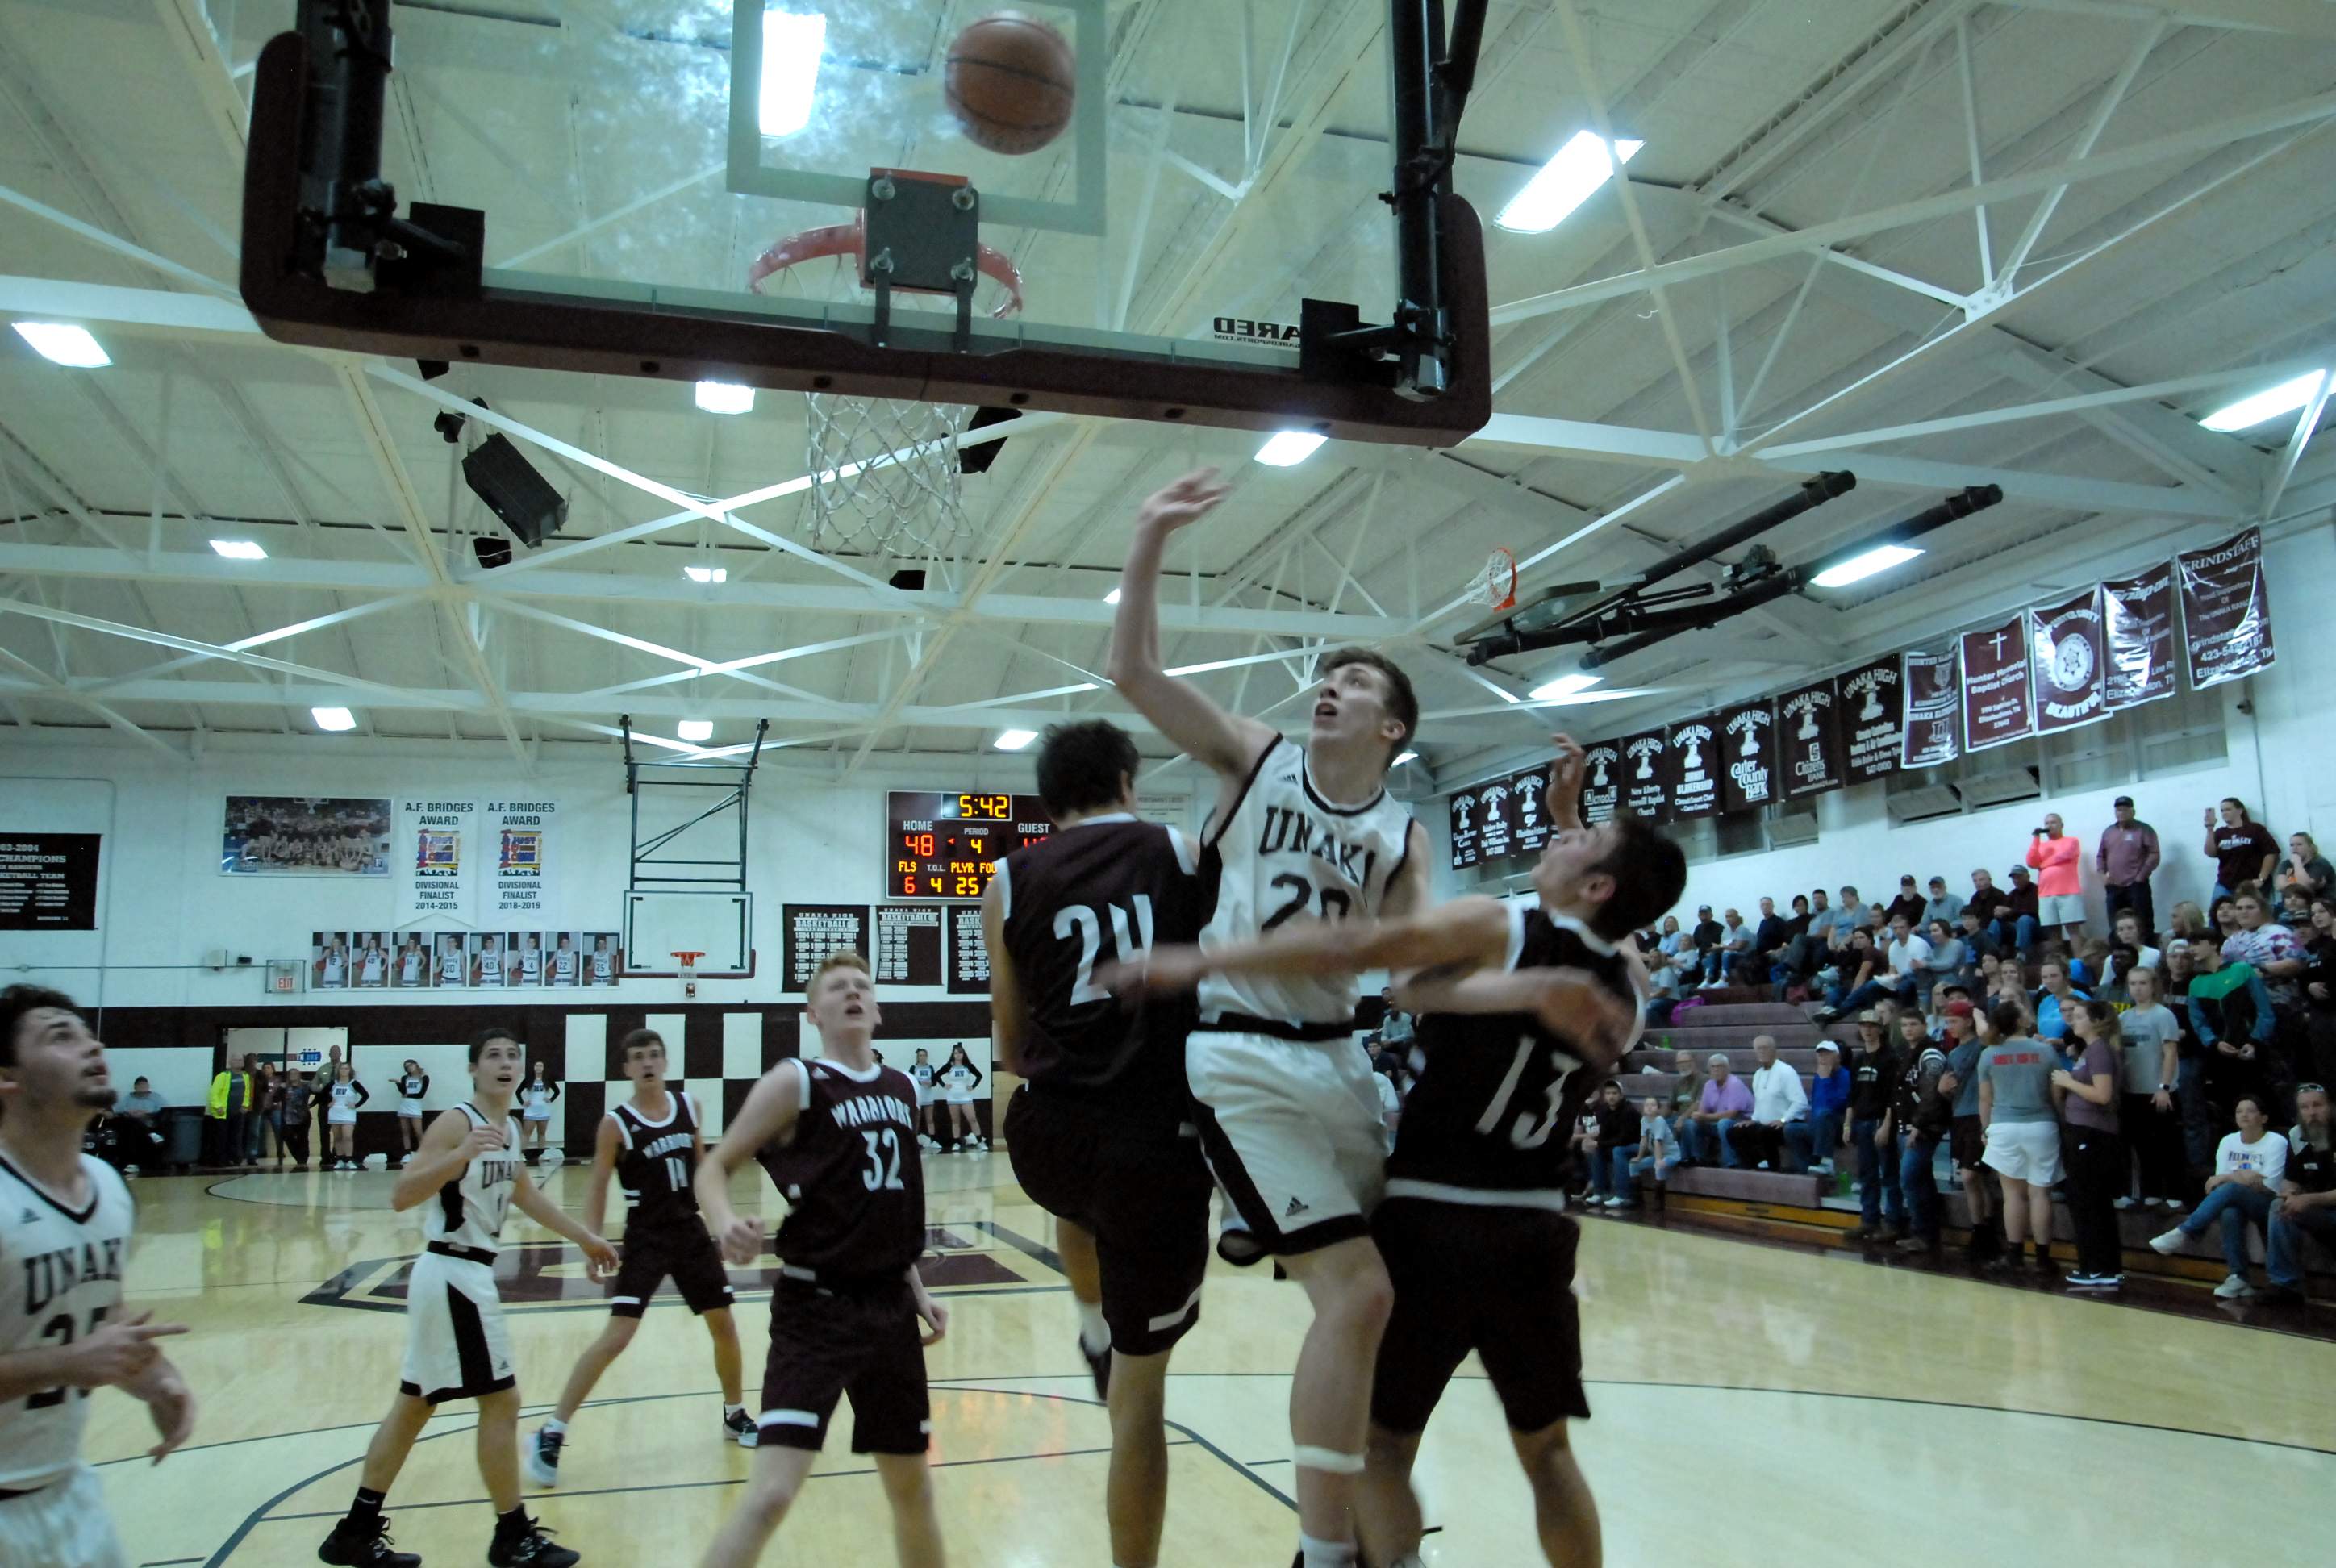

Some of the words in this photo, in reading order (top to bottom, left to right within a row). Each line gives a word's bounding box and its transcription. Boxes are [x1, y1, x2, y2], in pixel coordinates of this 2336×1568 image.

[1844, 671, 1874, 699] UNAKA
[1873, 668, 1898, 685] HIGH
[1967, 673, 1996, 685] Hunter
[1971, 682, 2001, 694] Baptist
[2001, 671, 2025, 686] Church
[1783, 692, 1810, 719] UNAKA
[1810, 691, 1832, 707] HIGH
[2045, 691, 2101, 719] BEAUTIFU
[1726, 711, 1753, 735] UNAKA
[1750, 710, 1771, 727] HIGH
[1672, 725, 1696, 749] UNAKA
[1694, 724, 1712, 741] HIGH
[1625, 738, 1647, 760] UNAKA
[1646, 737, 1663, 754] HIGH
[1730, 759, 1758, 779] Carter
[1737, 765, 1769, 790] County
[1745, 782, 1769, 800] Bank
[405, 803, 424, 812] A.F.
[427, 803, 473, 812] BRIDGES
[487, 803, 506, 812] A.F.
[509, 803, 555, 812] BRIDGES
[959, 795, 1007, 818] 5:42
[419, 815, 459, 826] AWARD
[502, 815, 540, 826] AWARD
[903, 820, 933, 832] HOME
[964, 828, 989, 836] PERIOD
[1018, 823, 1050, 834] GUEST
[0, 844, 39, 853] 03-2004
[905, 834, 934, 857] 48
[970, 838, 982, 854] 4
[898, 861, 917, 873] FLS
[927, 864, 946, 872] T.O.L.
[951, 862, 974, 874] PLYR
[980, 862, 997, 874] FOU
[415, 881, 460, 890] DIVISIONAL
[498, 881, 542, 890] DIVISIONAL
[904, 876, 916, 894] 6
[931, 878, 942, 893] 4
[956, 877, 979, 895] 25
[419, 891, 455, 899] FINALIST
[503, 891, 537, 899] FINALIST
[415, 901, 458, 910] 2014-2015
[498, 901, 541, 910] 2018-2019
[795, 919, 846, 928] BASKETBALL
[1053, 893, 1154, 1007] 24
[277, 978, 293, 989] EXIT
[1475, 1035, 1583, 1149] 13
[830, 1095, 913, 1130] WARRIOR
[861, 1127, 904, 1192] 32
[481, 1160, 514, 1190] UNA
[23, 1237, 123, 1316] UNAK
